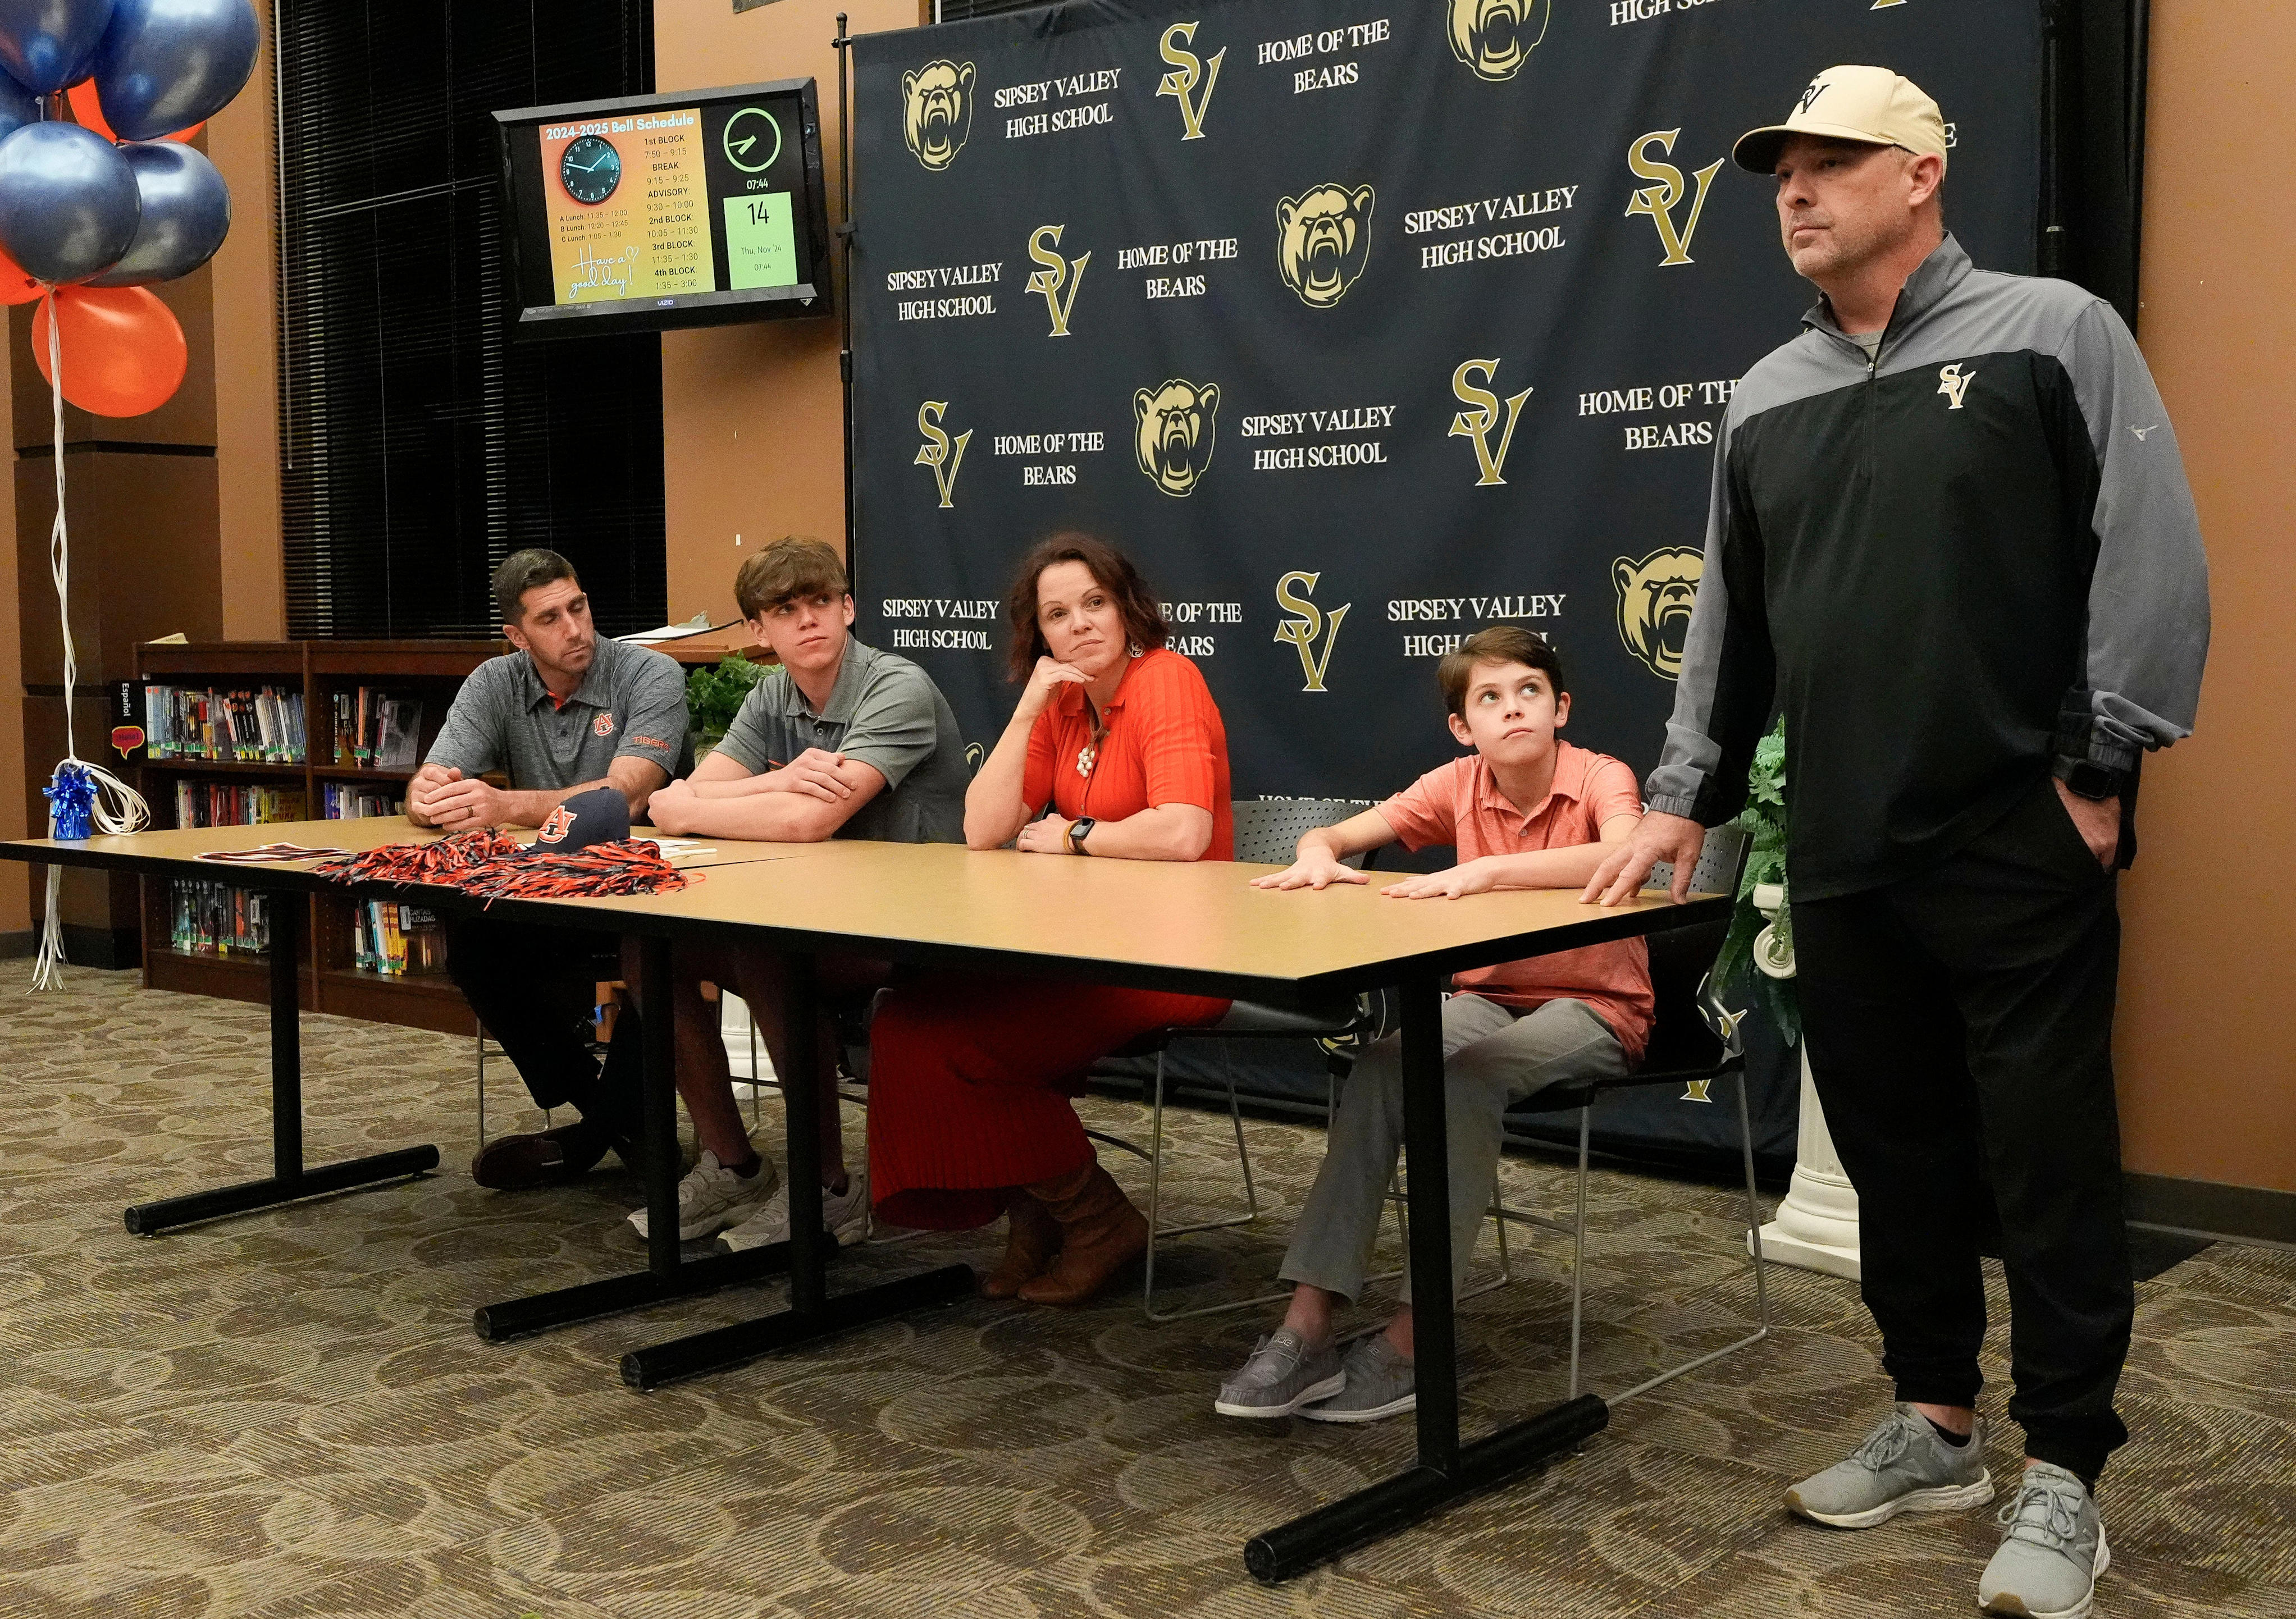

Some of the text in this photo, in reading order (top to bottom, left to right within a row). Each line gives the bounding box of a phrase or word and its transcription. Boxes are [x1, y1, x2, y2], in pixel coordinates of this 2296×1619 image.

[1610, 0, 1671, 26] HIGH
[1258, 19, 1390, 65] HOME OF THE
[994, 68, 1121, 108] SIPSEY VALLEY
[1294, 62, 1358, 94] BEARS
[546, 113, 694, 140] 2024-2025 Bell Schedule
[1006, 103, 1113, 138] HIGH SCHOOL
[659, 135, 684, 144] BLOCK
[645, 150, 660, 159] 7:50
[647, 176, 663, 185] 9:15
[747, 178, 768, 190] 07:44
[674, 200, 693, 209] 10:00
[747, 201, 769, 225] 14
[1405, 185, 1578, 234] SIPSEY VALLEY
[647, 229, 668, 238] 10:05
[678, 226, 698, 235] 11:30
[649, 216, 663, 225] 2nd
[571, 243, 615, 277] Have
[1118, 238, 1238, 269] HOME OF THE
[1421, 226, 1565, 268] HIGH SCHOOL
[569, 266, 599, 299] good
[888, 263, 1002, 291] SIPSEY VALLEY
[1146, 275, 1206, 299] BEARS
[898, 295, 996, 321] HIGH SCHOOL
[1579, 379, 1741, 415] HOME OF TH
[1241, 406, 1396, 436] SIPSEY VALLEY
[994, 432, 1104, 455] HOME OF THE
[1624, 422, 1712, 450] BEARS
[1254, 443, 1387, 469] HIGH SCHOOL
[1024, 465, 1076, 485] BEARS
[883, 600, 999, 619] SIPSEY VALLEY
[1177, 603, 1203, 622] OF
[1206, 603, 1242, 623] THE
[1388, 594, 1565, 621] SIPSEY VALLEY
[893, 629, 992, 650] HIGH SCHOOL
[1166, 636, 1214, 656] EARS
[1404, 635, 1460, 656] HIGH
[121, 683, 131, 716] Español
